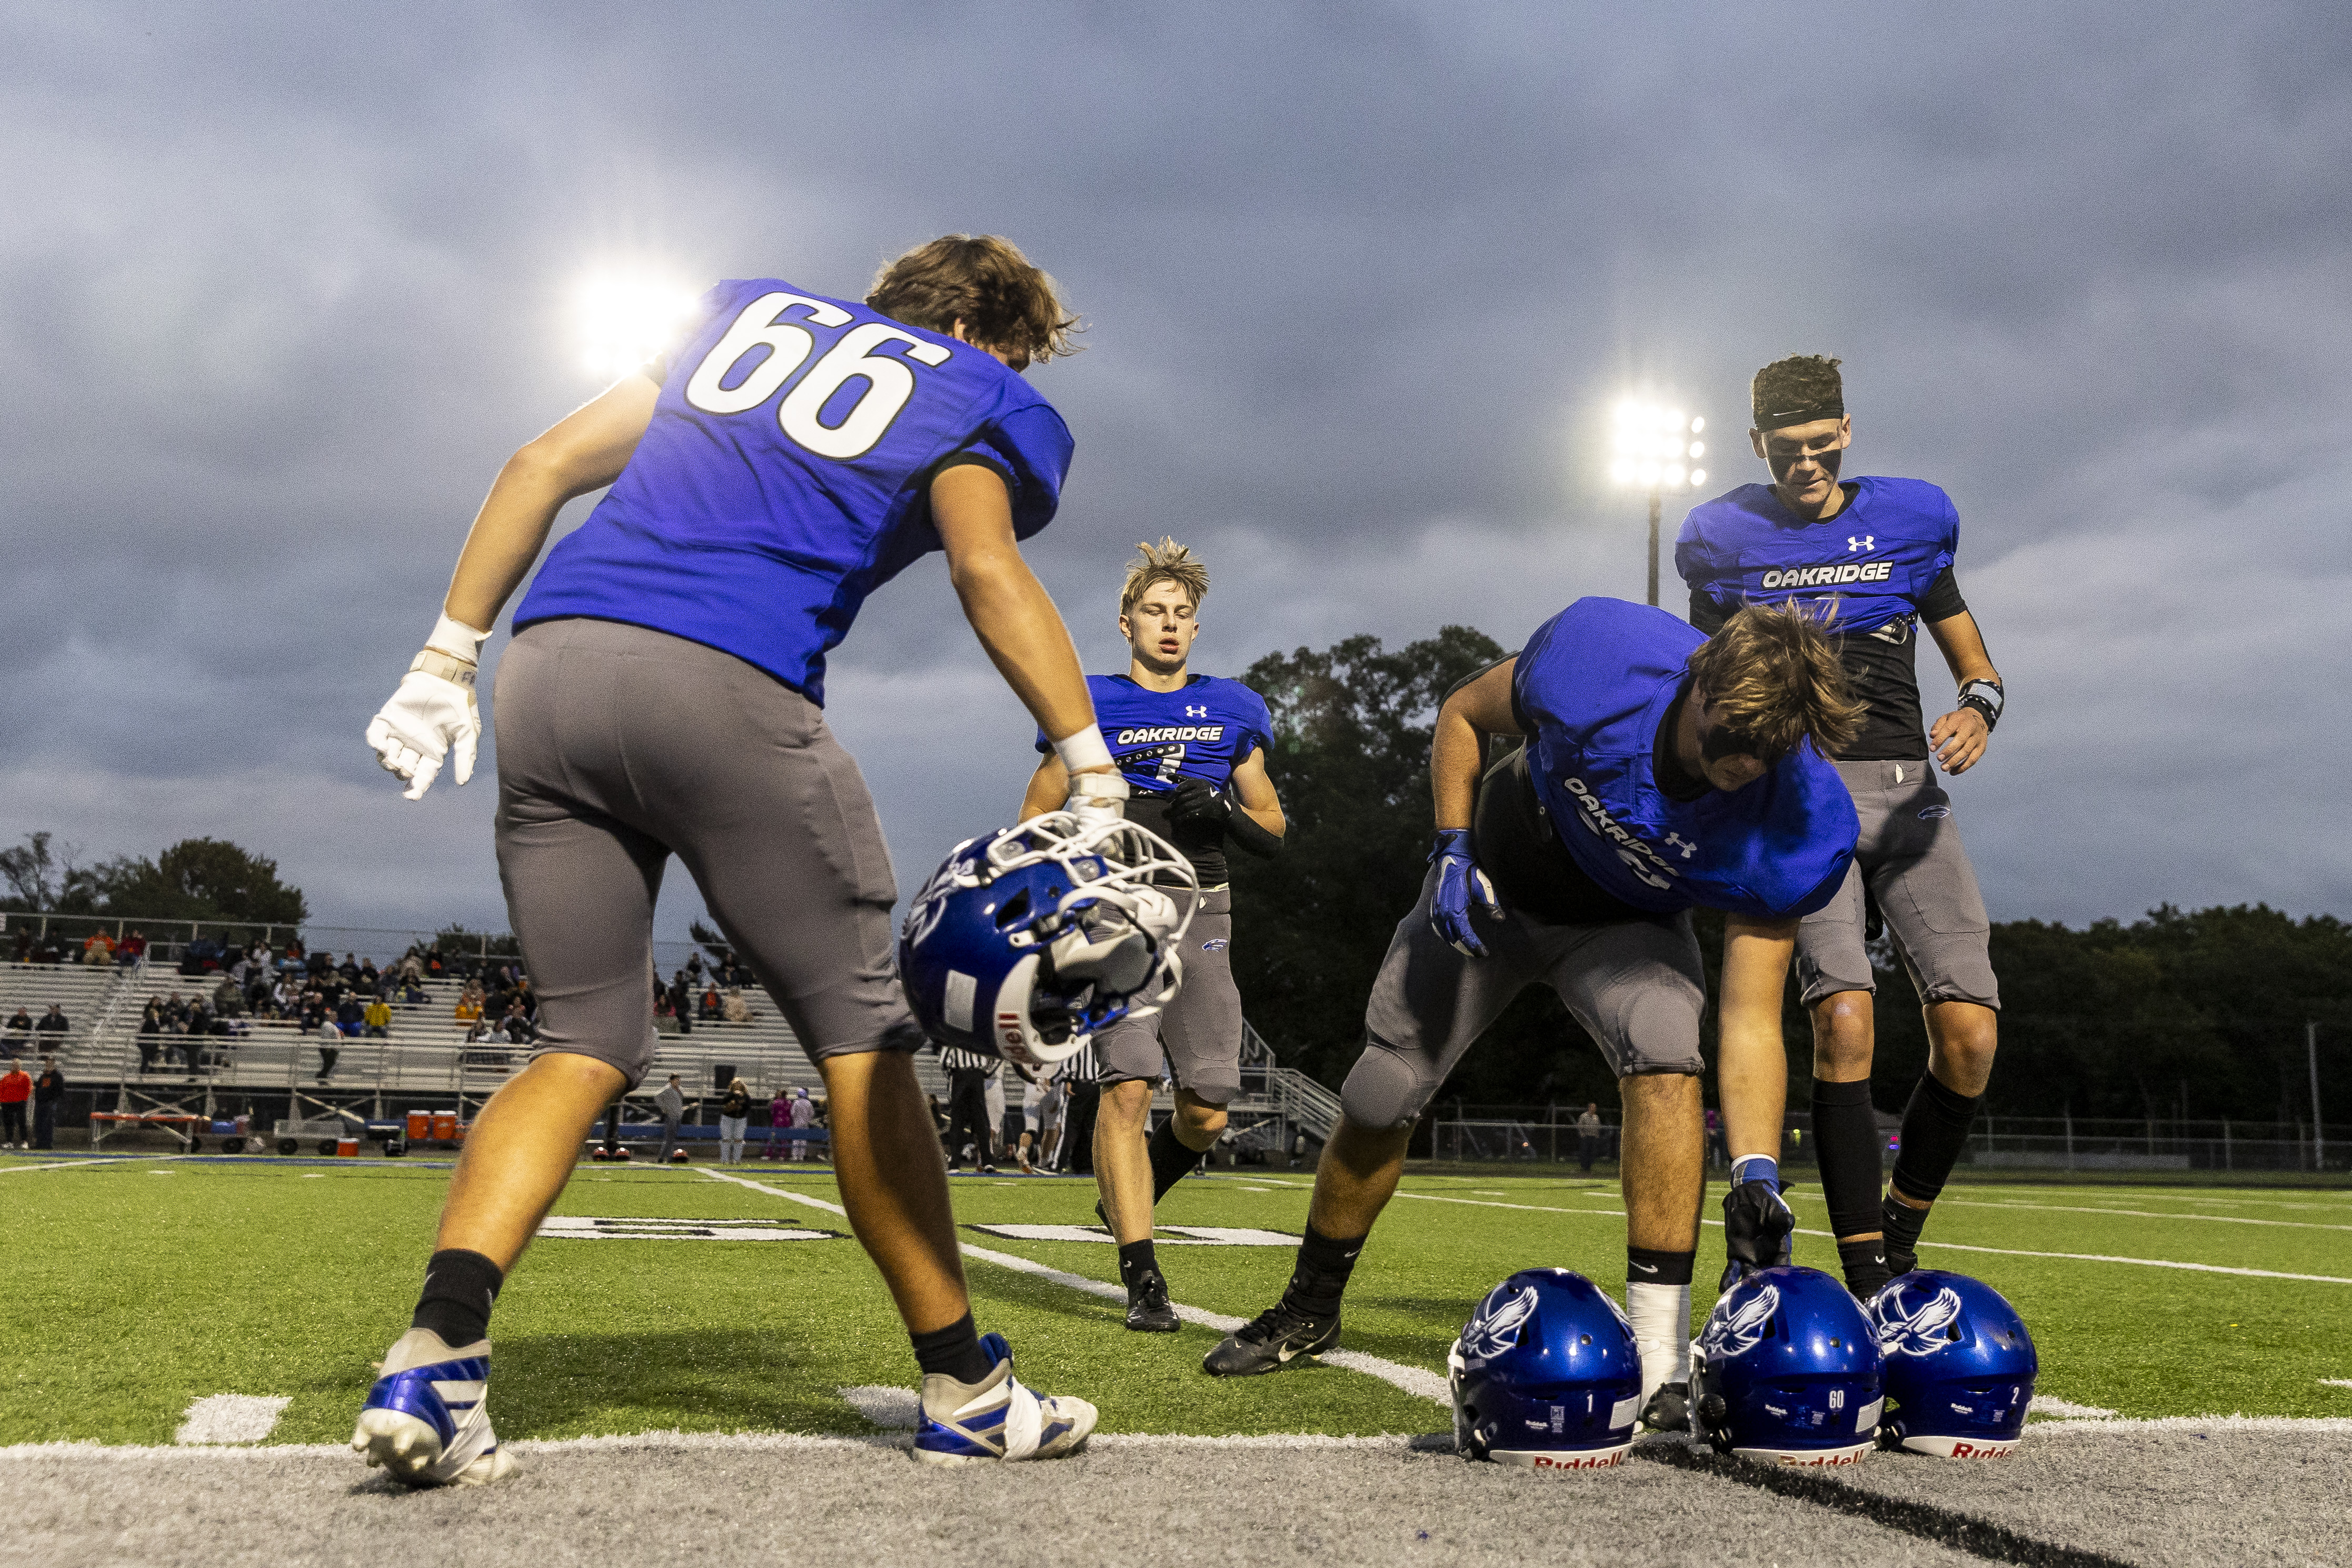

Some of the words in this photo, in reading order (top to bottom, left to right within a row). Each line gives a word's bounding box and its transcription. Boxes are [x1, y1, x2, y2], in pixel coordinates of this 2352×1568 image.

[686, 291, 952, 461] 66
[1762, 562, 1893, 589] OAKRIDGE
[1117, 726, 1224, 745] OAKRIDGE
[1586, 1394, 1593, 1412] 1
[1829, 1390, 1844, 1409] 60
[2011, 1387, 2019, 1404] 2
